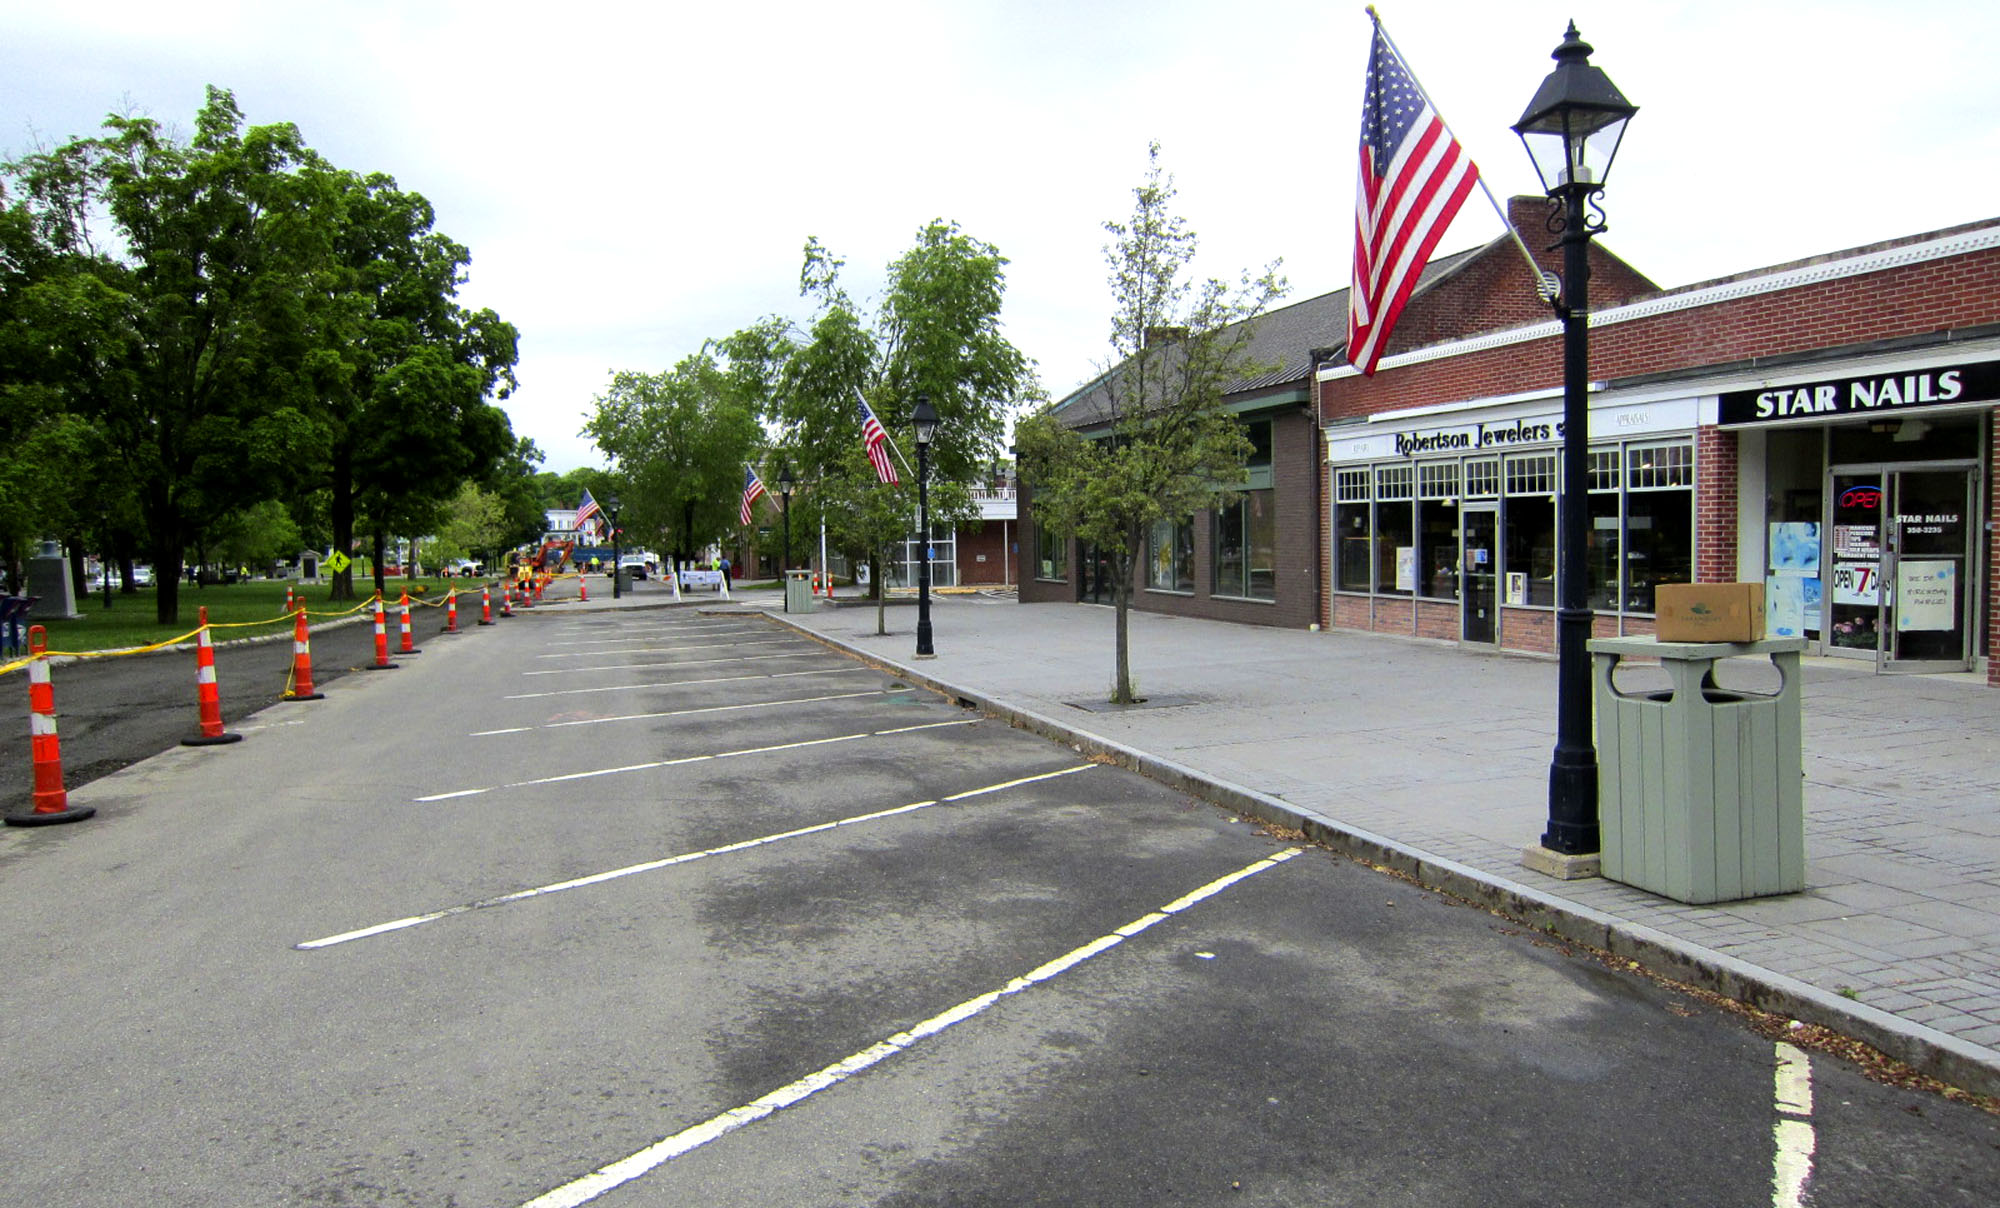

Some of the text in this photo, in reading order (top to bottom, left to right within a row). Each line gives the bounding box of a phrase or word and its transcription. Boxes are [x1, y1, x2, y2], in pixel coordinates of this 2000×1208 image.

[1756, 370, 1962, 418] STAR NAILS
[1395, 433, 1469, 457] Robertson
[1475, 420, 1551, 450] Jewelers
[1895, 514, 1959, 524] STAR NAILS
[1834, 569, 1854, 589] OPEN
[1855, 567, 1871, 592] 7
